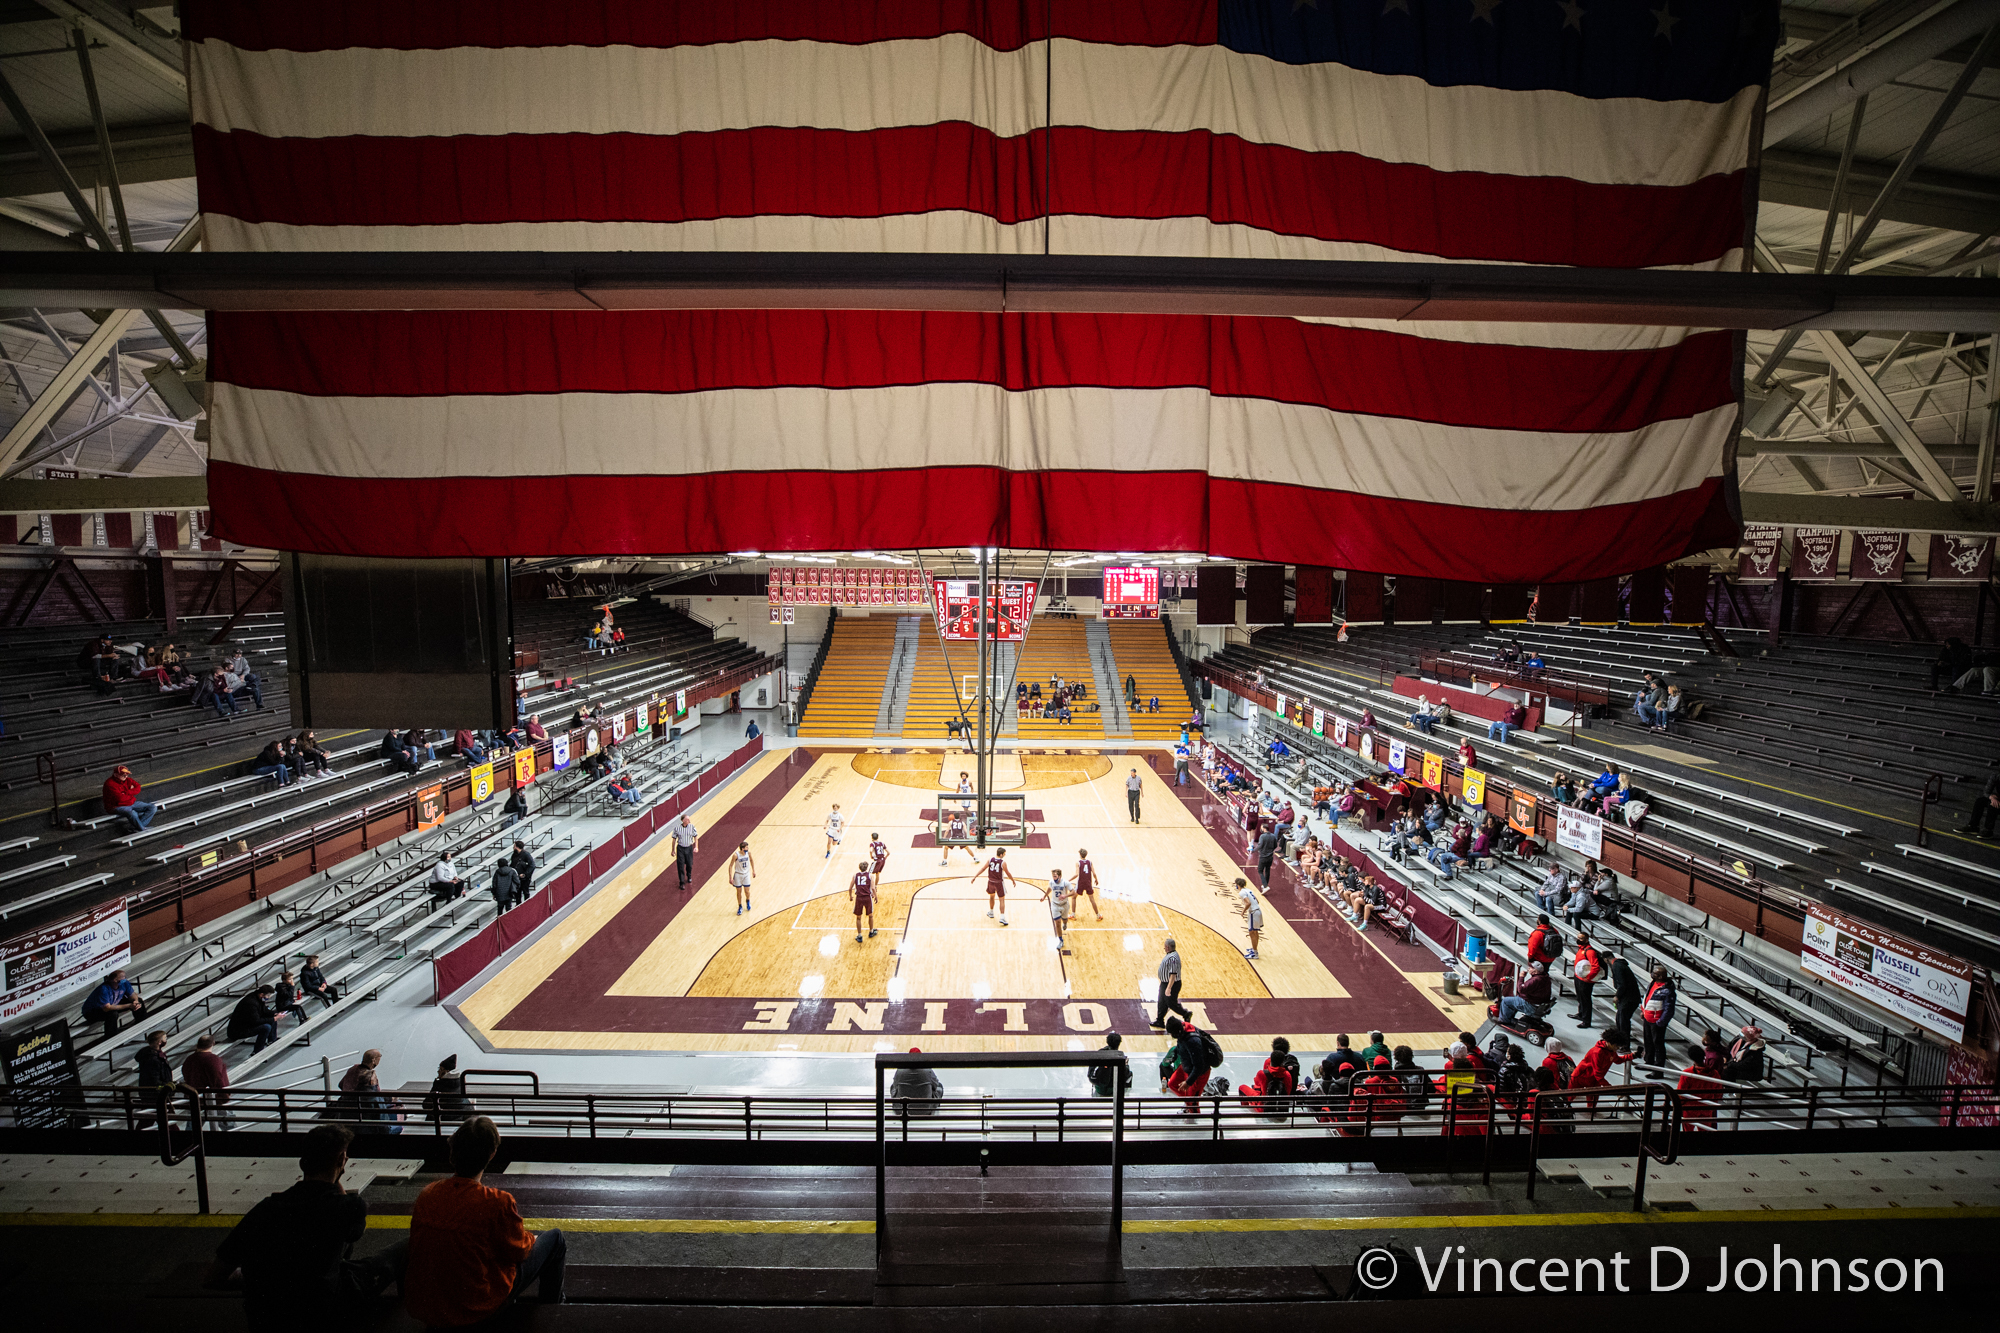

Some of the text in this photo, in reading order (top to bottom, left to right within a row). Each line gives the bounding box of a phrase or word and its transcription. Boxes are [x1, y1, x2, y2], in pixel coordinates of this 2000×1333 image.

[41, 515, 52, 544] BOYS
[96, 517, 106, 546] GIRLS
[1744, 531, 1782, 540] CHAMPIONS
[936, 583, 946, 637] MAROONS
[1009, 606, 1020, 618] 12
[480, 783, 486, 794] S
[1470, 788, 1475, 799] S
[990, 862, 999, 872] 34
[1083, 864, 1088, 873] 4
[857, 876, 866, 885] 12
[24, 941, 34, 949] to
[38, 934, 57, 944] Our
[60, 920, 91, 936] Maroon
[93, 900, 125, 922] Sponsors!
[102, 918, 125, 941] ORA
[56, 931, 98, 956] RUSSELL
[1807, 932, 1830, 948] POINT
[1810, 907, 1832, 921] Thank
[1834, 918, 1847, 928] You
[1860, 929, 1875, 940] Our
[1878, 936, 1914, 956] Maroon
[1917, 952, 1968, 976] Sponsors!
[1838, 941, 1870, 959] OLDE TOWN
[10, 955, 52, 975] OLDE TOWN
[14, 988, 31, 998] You
[45, 976, 59, 985] Our
[86, 948, 115, 968] Sponsors!
[1874, 948, 1921, 978] RUSSELL
[1817, 952, 1836, 964] Thank
[1838, 962, 1851, 972] You
[1862, 973, 1875, 982] Our
[1877, 980, 1900, 994] White
[1902, 992, 1942, 1012] Sponsors!
[1927, 978, 1960, 1003] ORA
[742, 1001, 1218, 1032] MOLINE
[1932, 1015, 1962, 1032] LANGMAN
[10, 1042, 62, 1067] TEAM SALES
[14, 1075, 31, 1084] YOUR
[32, 1068, 47, 1078] TEAM
[48, 1060, 66, 1070] NEEDS
[24, 1067, 35, 1076] THE
[36, 1060, 52, 1071] GEAR
